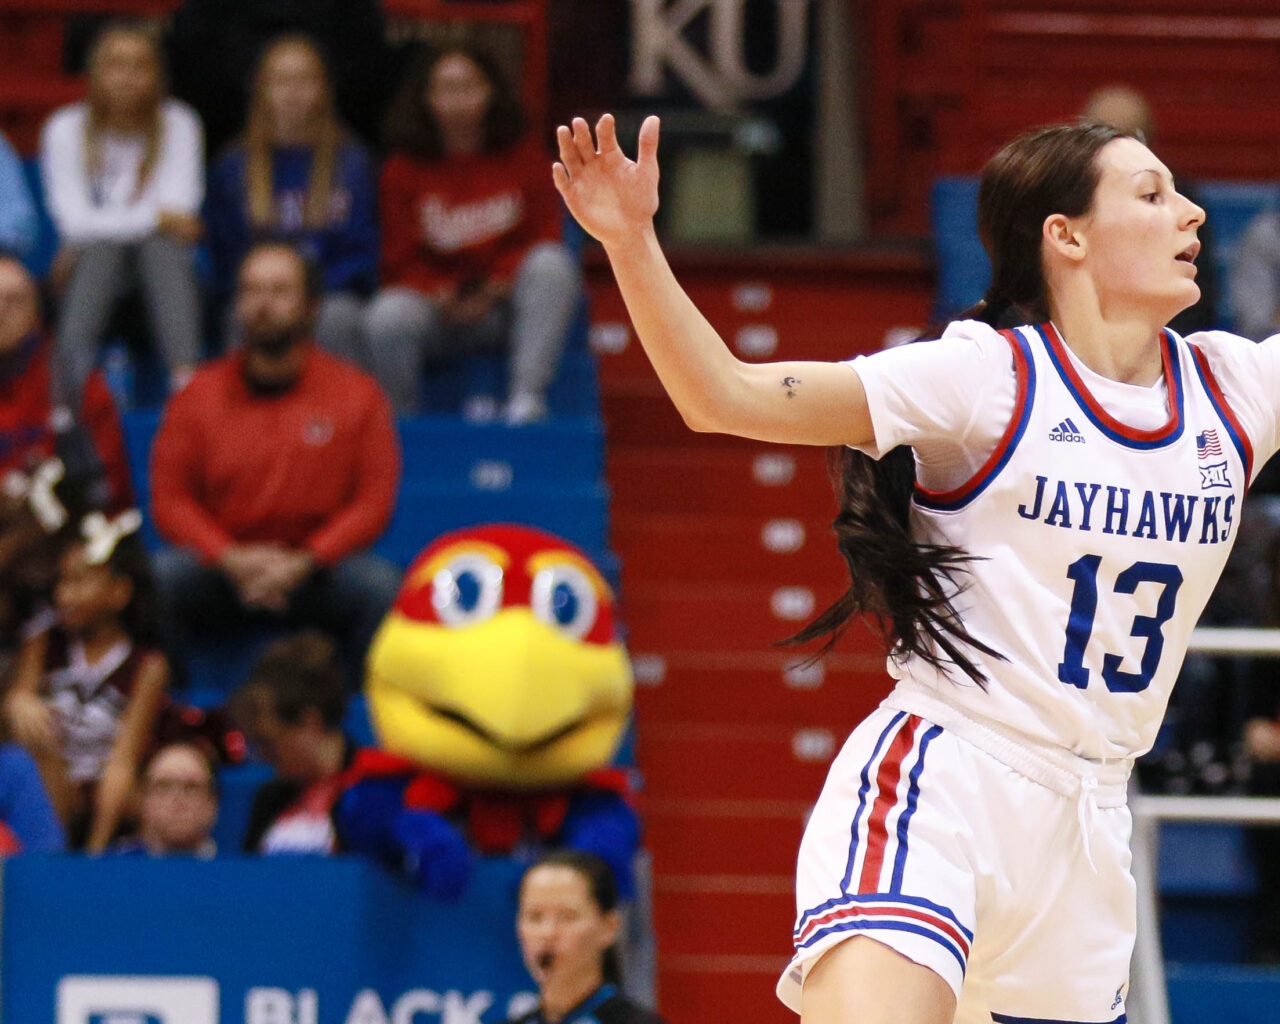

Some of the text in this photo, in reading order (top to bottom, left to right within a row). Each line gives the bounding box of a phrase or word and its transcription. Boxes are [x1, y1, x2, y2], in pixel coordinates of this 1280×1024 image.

[630, 0, 808, 114] KU
[1048, 432, 1086, 444] adidas
[1018, 475, 1236, 544] JAYHAWKS
[1058, 553, 1184, 693] 13
